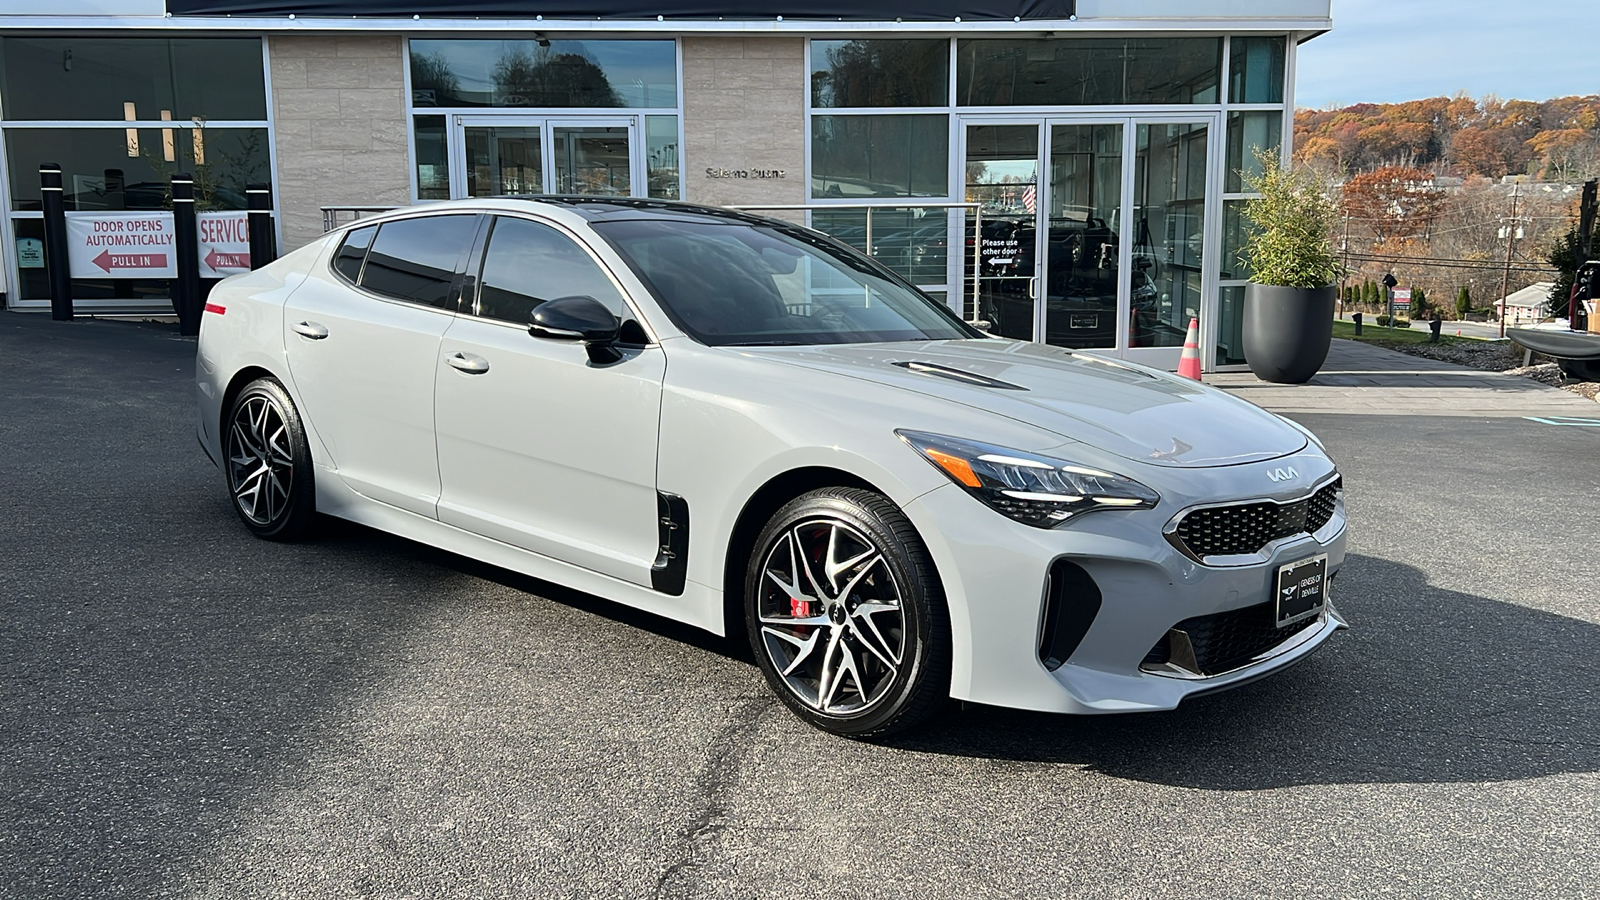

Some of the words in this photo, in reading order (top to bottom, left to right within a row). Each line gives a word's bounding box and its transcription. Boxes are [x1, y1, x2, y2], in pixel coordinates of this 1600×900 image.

[705, 167, 748, 179] Salerno
[750, 167, 786, 179] Duane
[93, 221, 124, 232] DOOR
[126, 220, 163, 232] OPENS
[86, 234, 173, 246] AUTOMATICALLY
[112, 256, 137, 266] PULL
[140, 256, 151, 266] IN
[216, 256, 232, 266] PULL
[1266, 466, 1299, 483] KIA
[1300, 576, 1316, 588] GENESIS
[1315, 573, 1321, 583] OF
[1301, 585, 1319, 598] DENVILLE
